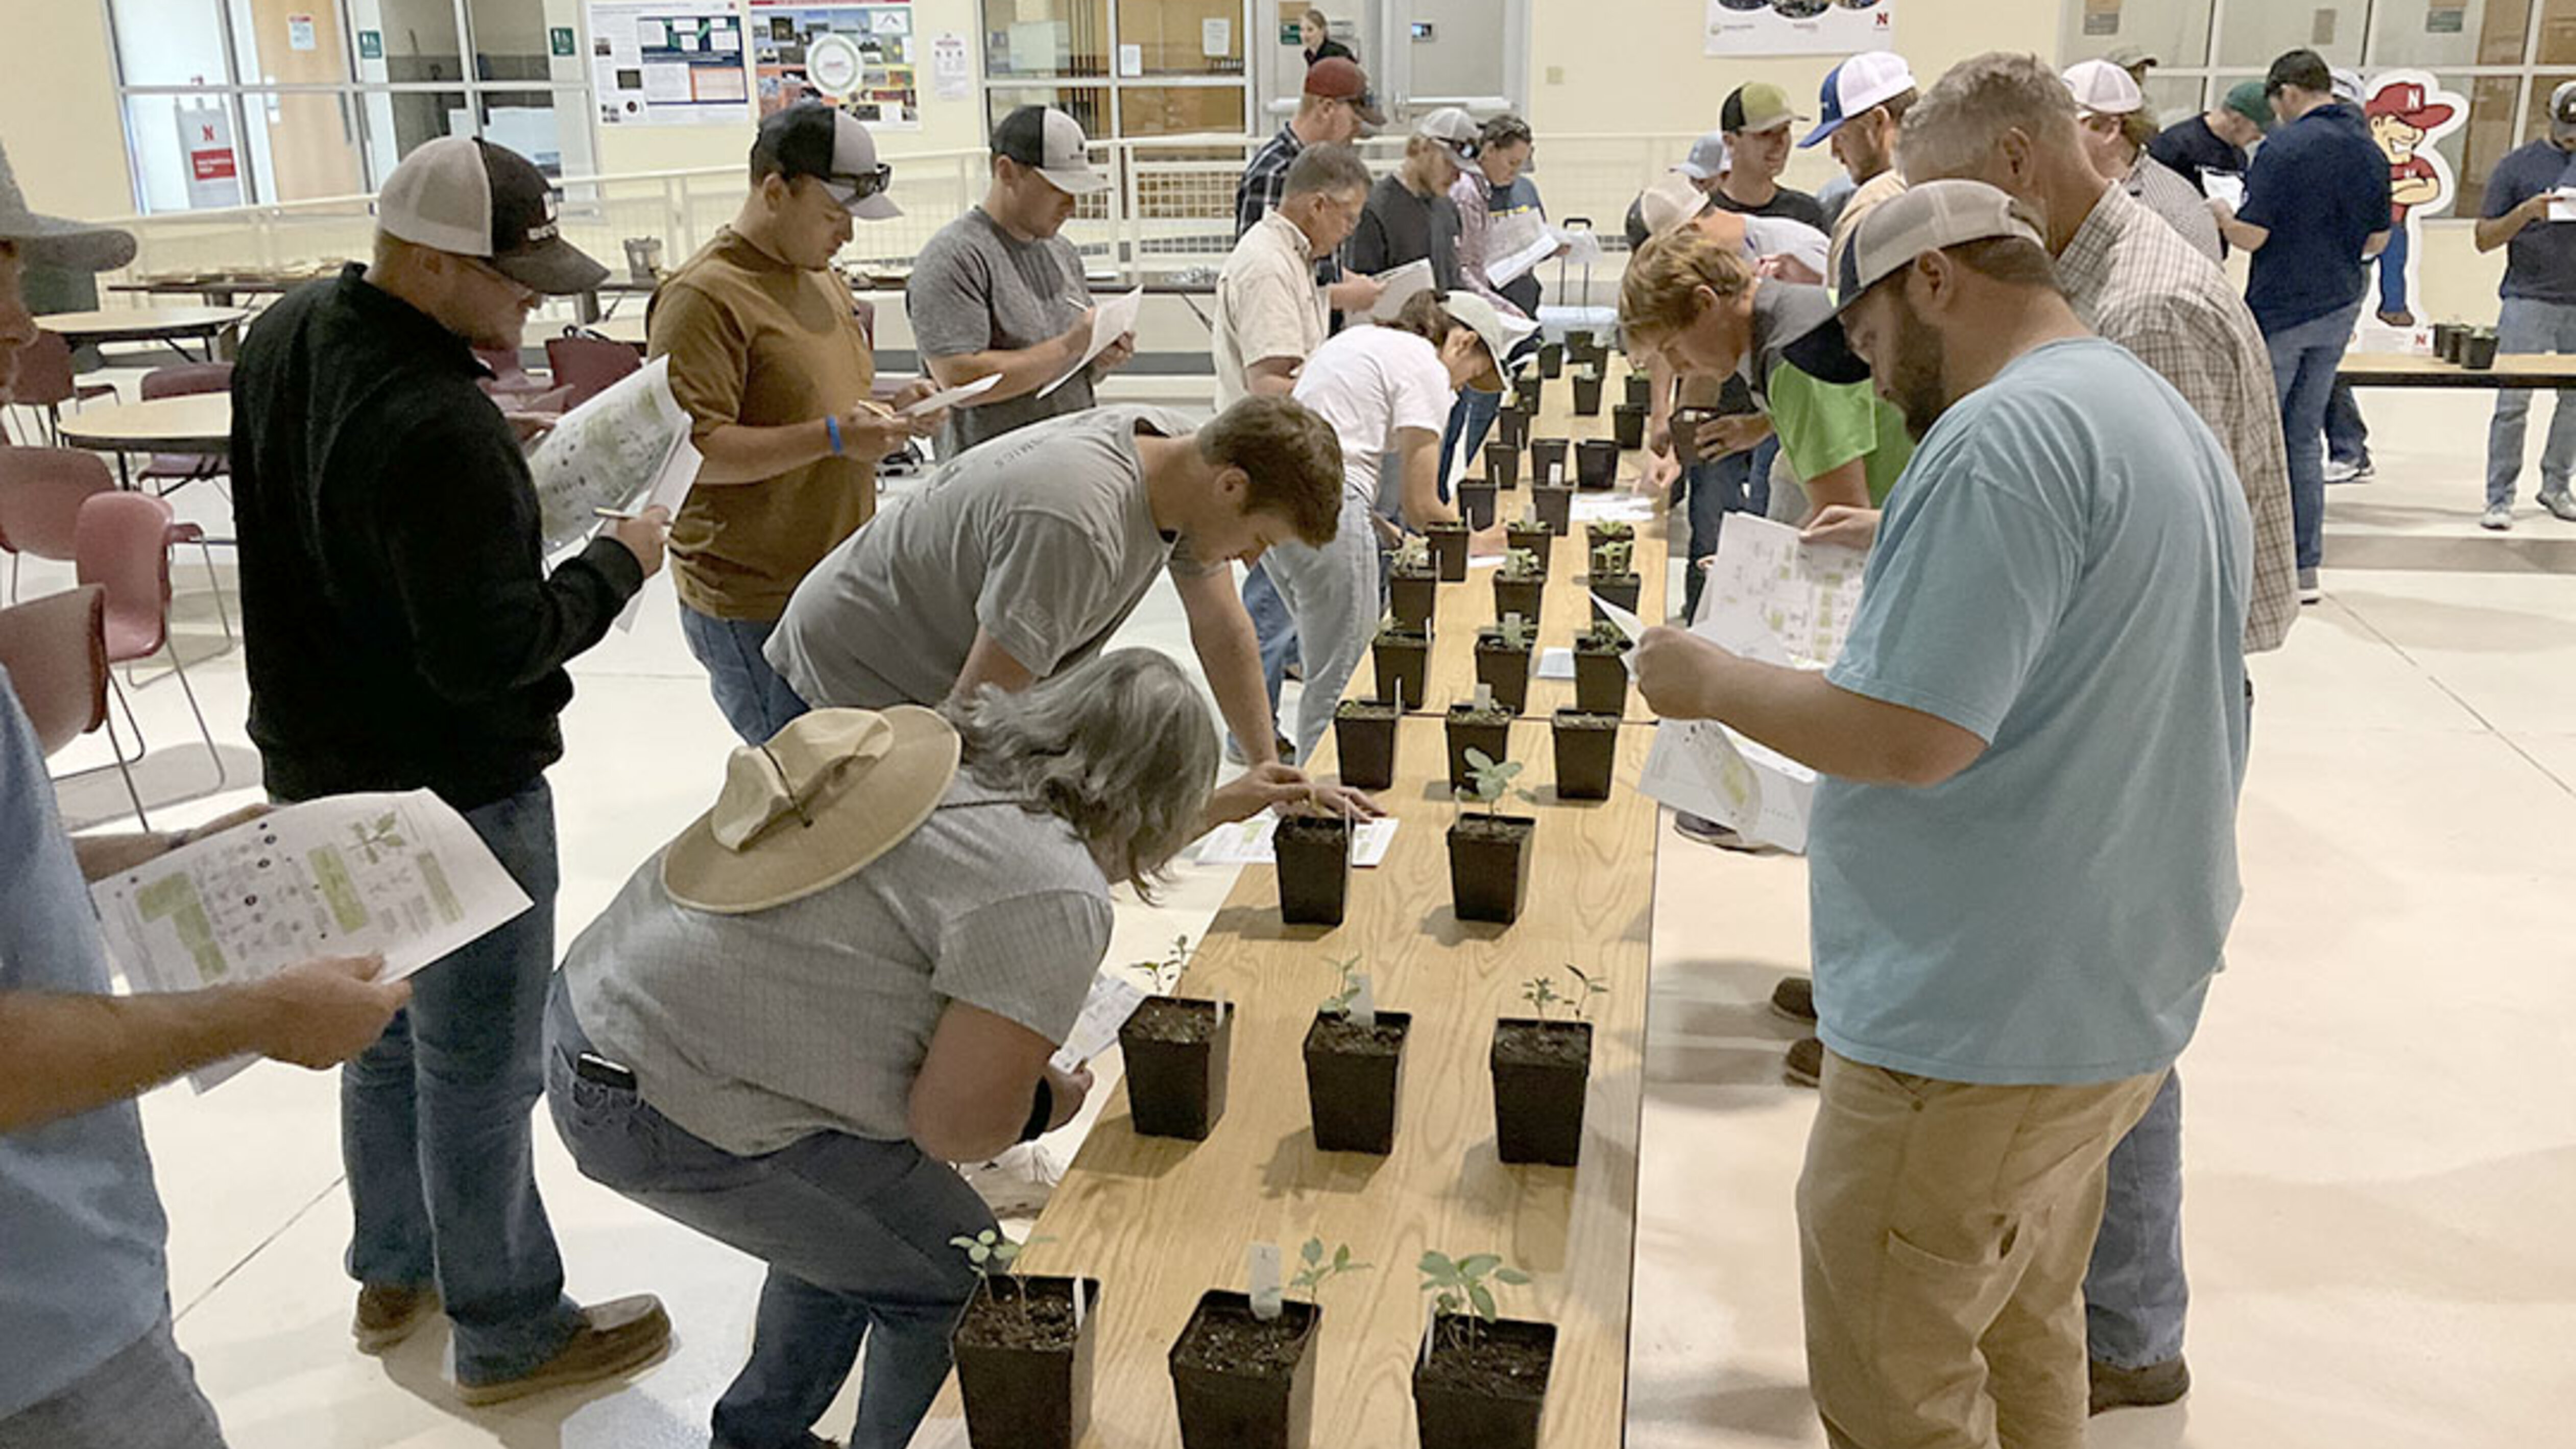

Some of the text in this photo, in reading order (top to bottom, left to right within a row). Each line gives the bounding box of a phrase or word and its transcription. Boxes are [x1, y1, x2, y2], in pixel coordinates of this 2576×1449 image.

[1876, 13, 1888, 25] N
[2408, 89, 2420, 109] N
[202, 124, 213, 141] N
[2415, 333, 2426, 345] N
